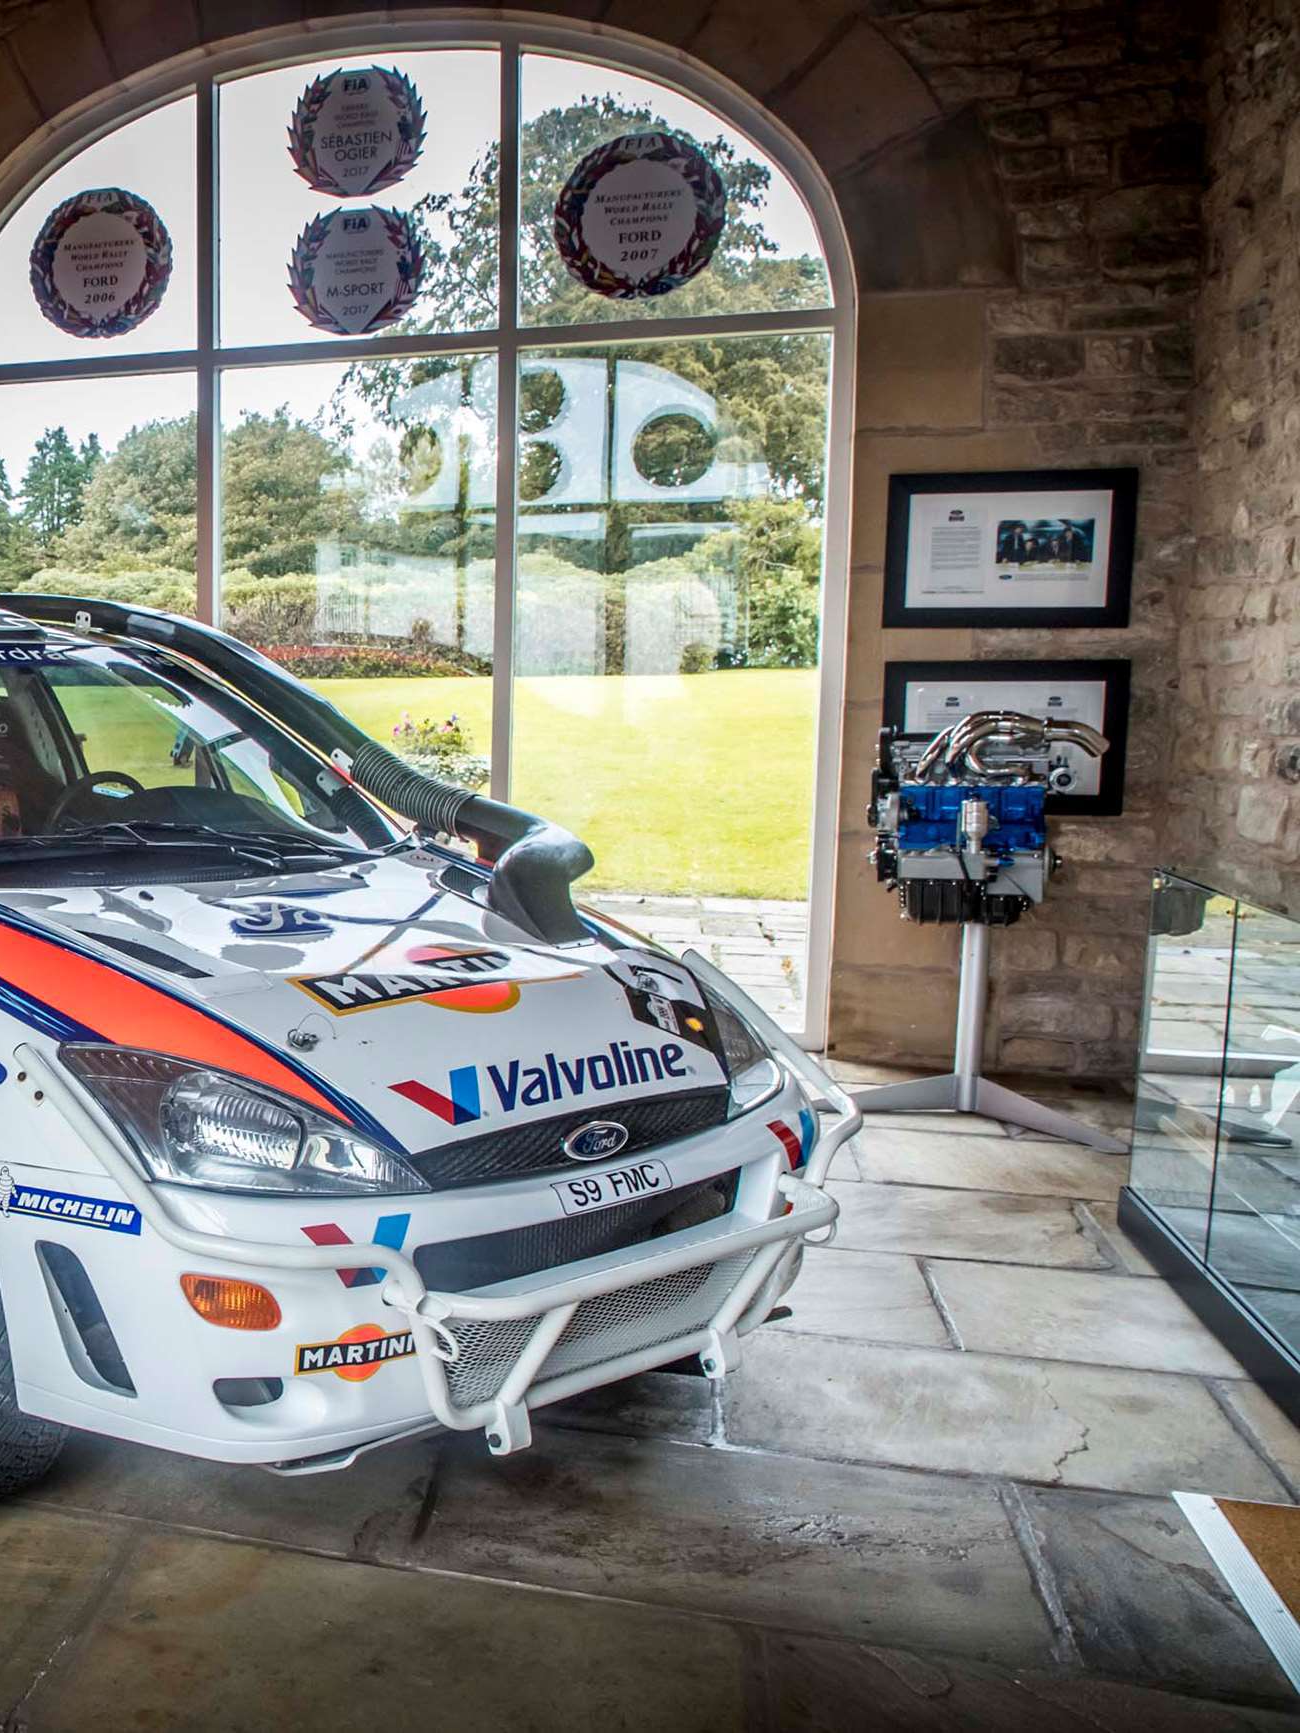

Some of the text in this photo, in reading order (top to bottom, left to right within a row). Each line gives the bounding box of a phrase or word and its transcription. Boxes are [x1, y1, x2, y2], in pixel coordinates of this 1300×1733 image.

[320, 130, 392, 150] SÉBASTIEN
[334, 146, 378, 161] OGIER
[342, 166, 370, 178] 2017
[619, 230, 662, 244] FORD
[620, 249, 658, 262] 2007
[83, 275, 118, 288] FORD
[326, 282, 385, 298] M-SPORT
[84, 293, 116, 304] 2006
[343, 305, 370, 316] 2017
[487, 1041, 686, 1112] Valvoline
[582, 1129, 618, 1153] Ford
[568, 1164, 659, 1207] S9 FMC
[17, 1192, 136, 1226] MICHELIN
[303, 1334, 413, 1369] MARTINI
